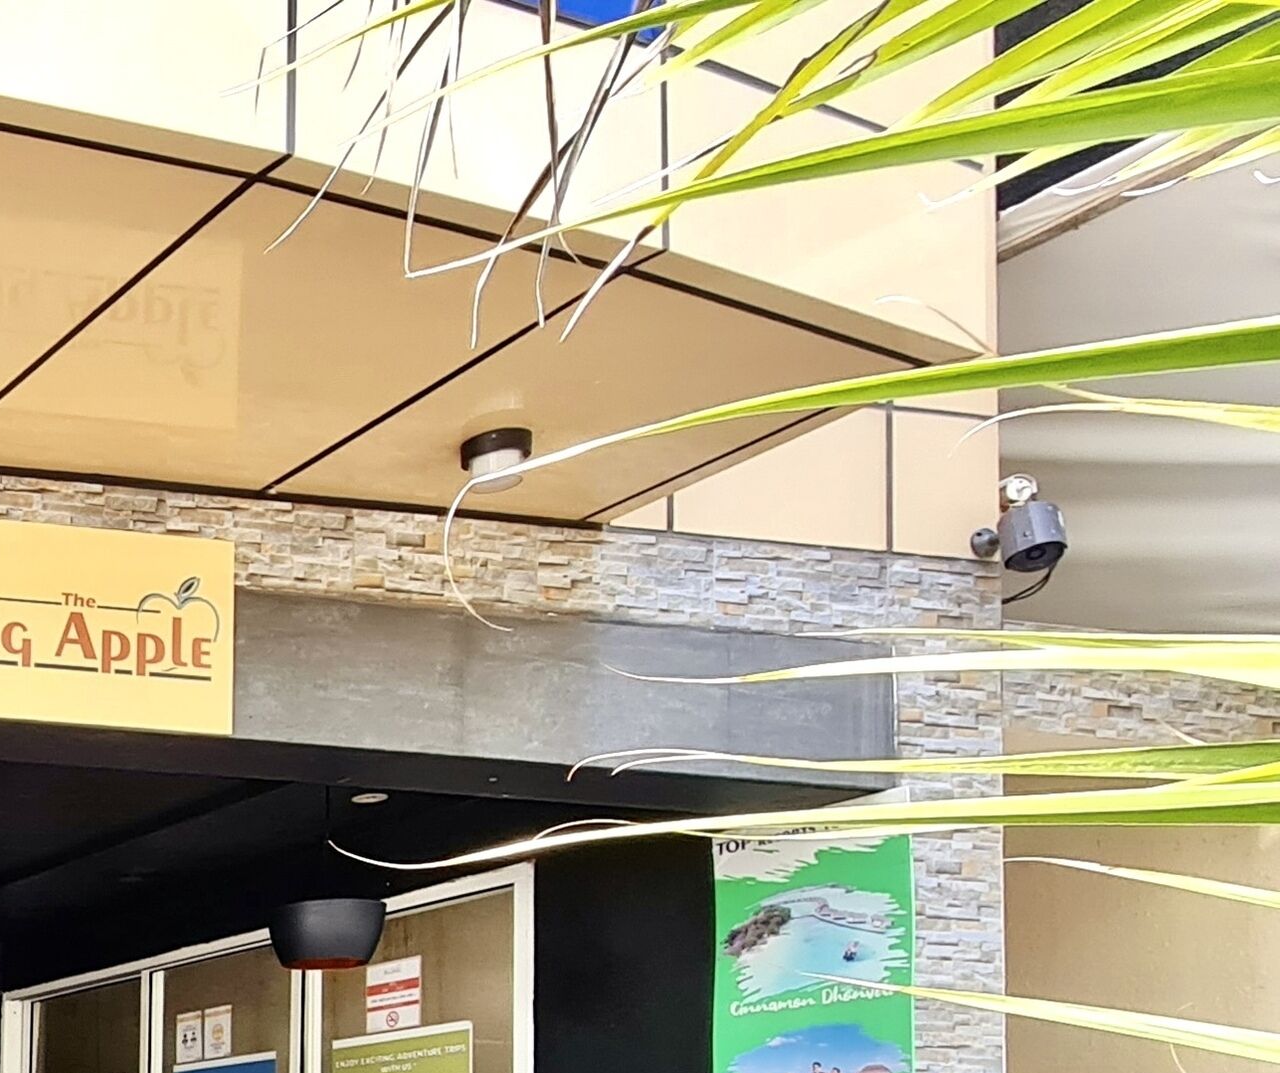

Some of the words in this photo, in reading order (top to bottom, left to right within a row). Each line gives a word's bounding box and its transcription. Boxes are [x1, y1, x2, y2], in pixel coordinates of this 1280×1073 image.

[61, 592, 97, 608] The
[54, 611, 212, 676] Apple
[730, 995, 816, 1016] Cinnamon
[397, 1046, 442, 1061] ADVENTURE
